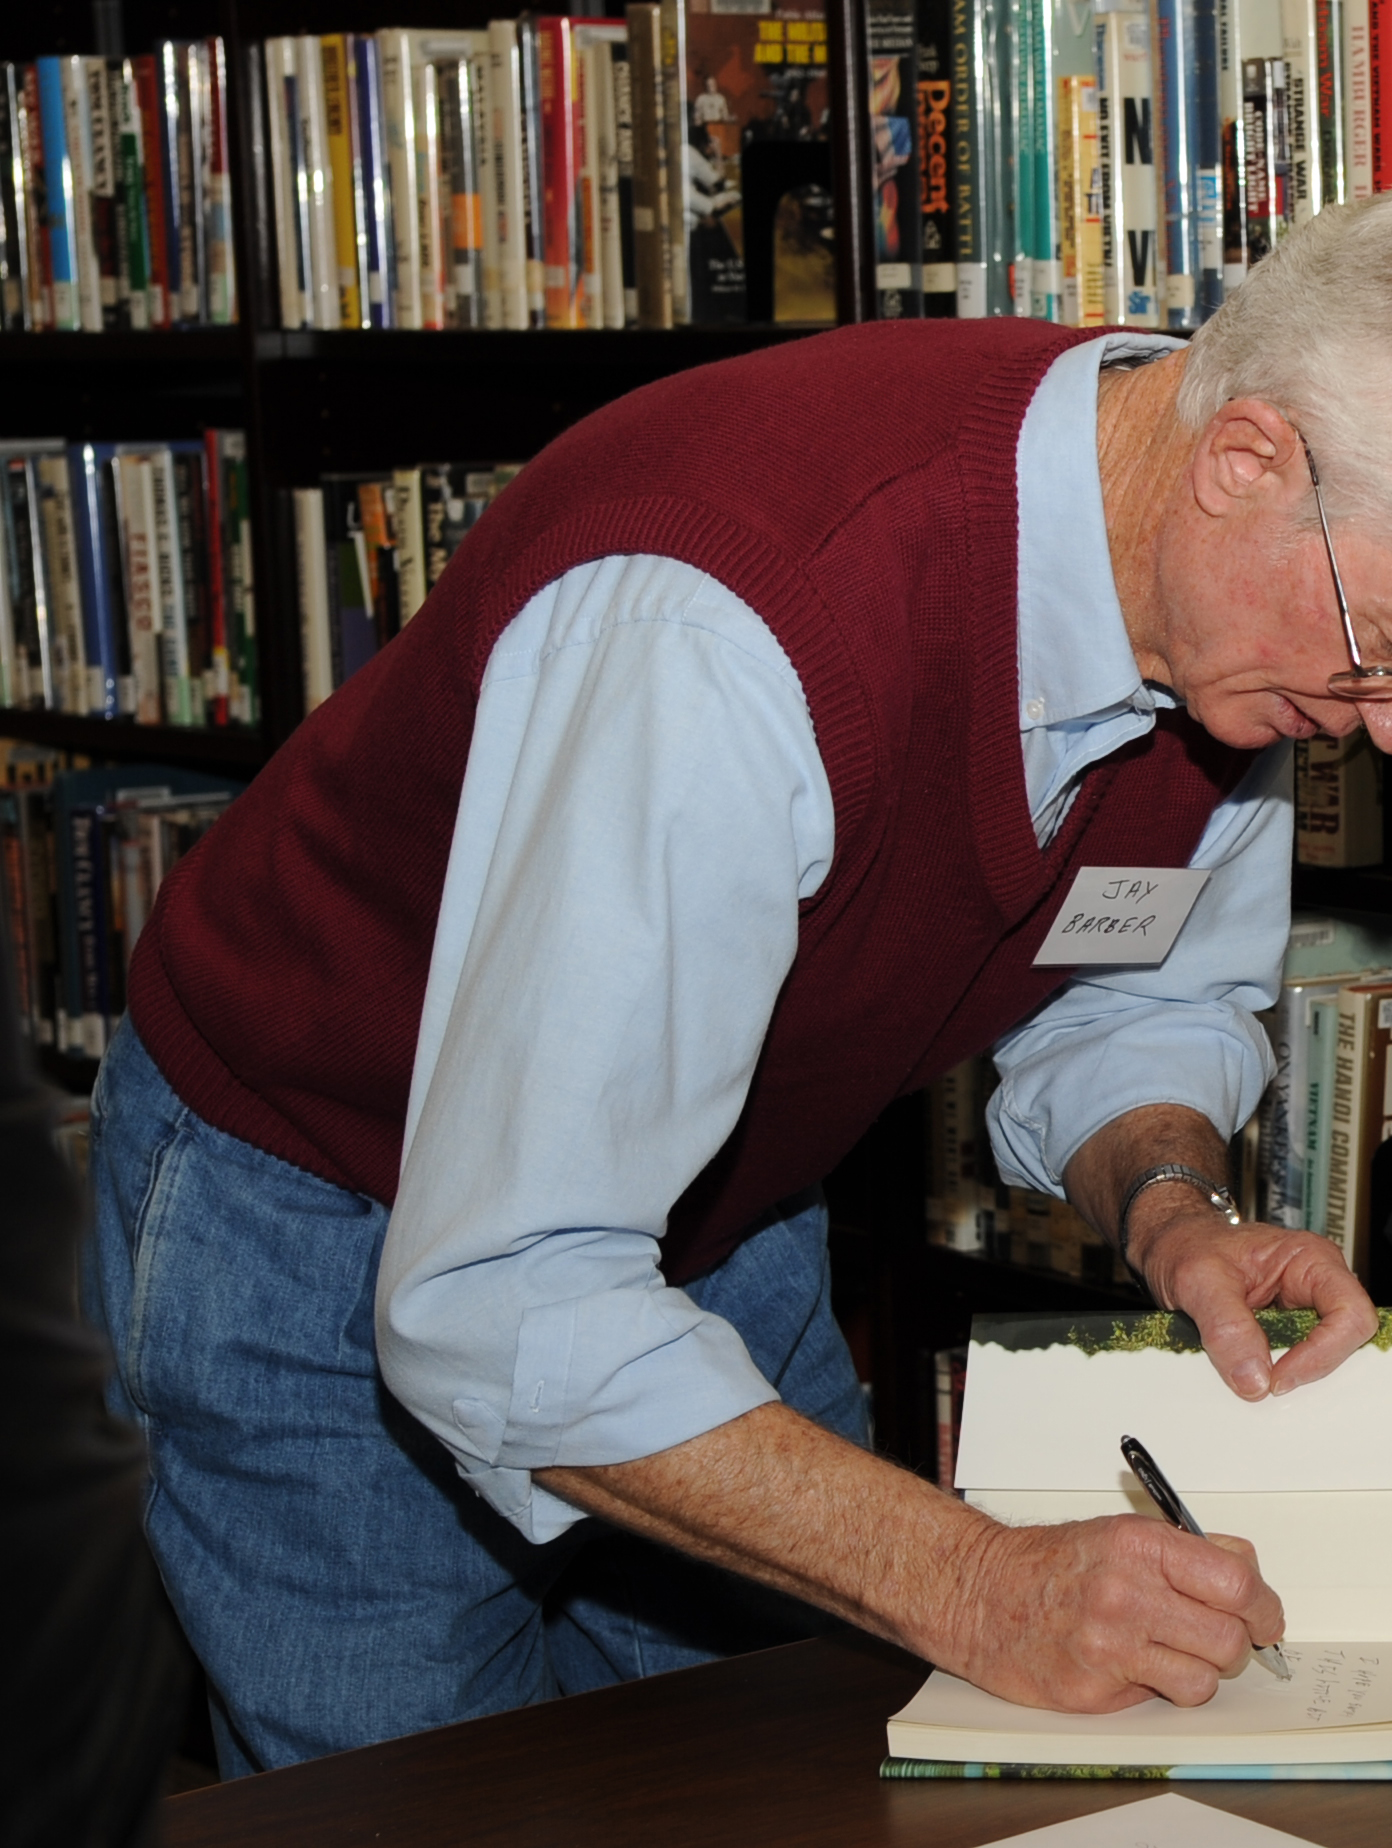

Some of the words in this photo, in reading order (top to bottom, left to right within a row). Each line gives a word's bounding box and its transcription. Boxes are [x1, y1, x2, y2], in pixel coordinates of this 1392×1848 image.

[1317, 0, 1331, 68] etnam
[1371, 35, 1381, 61] THE
[954, 43, 969, 132] ORDER
[1293, 77, 1307, 152] STRANGE
[1351, 25, 1367, 167] HAMBURGER
[1371, 66, 1381, 128] VIETNAM
[920, 80, 951, 214] Decent
[957, 141, 970, 176] OF
[958, 184, 972, 259] BATTL
[131, 532, 152, 632] FIASCO
[1061, 913, 1156, 937] BARBER
[1102, 879, 1159, 904] JAY
[1337, 1011, 1356, 1050] THE
[1306, 1082, 1319, 1151] VIETNAM
[1333, 1056, 1354, 1125] HANOI
[1326, 1129, 1350, 1248] COMMITME
